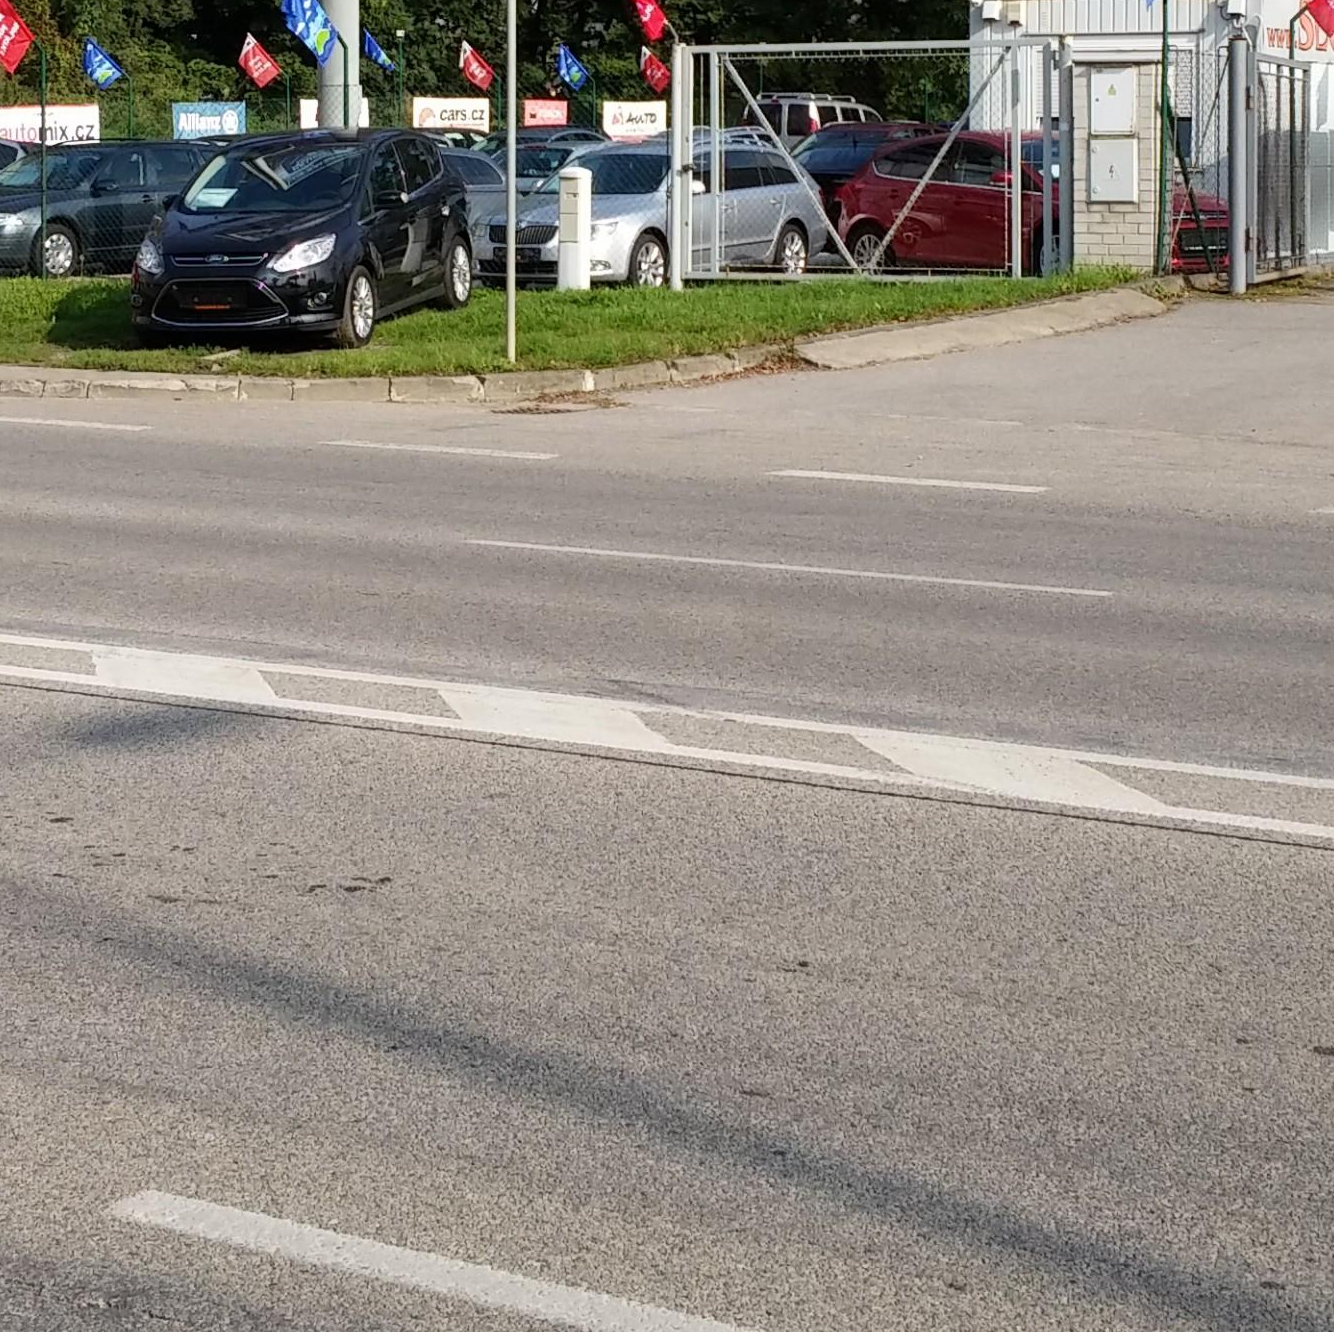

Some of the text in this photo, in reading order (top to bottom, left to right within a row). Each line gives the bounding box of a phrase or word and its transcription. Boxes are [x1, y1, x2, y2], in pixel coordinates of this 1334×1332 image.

[178, 112, 221, 131] Allianz
[440, 108, 485, 122] cars.cz
[0, 120, 95, 142] automix.cz
